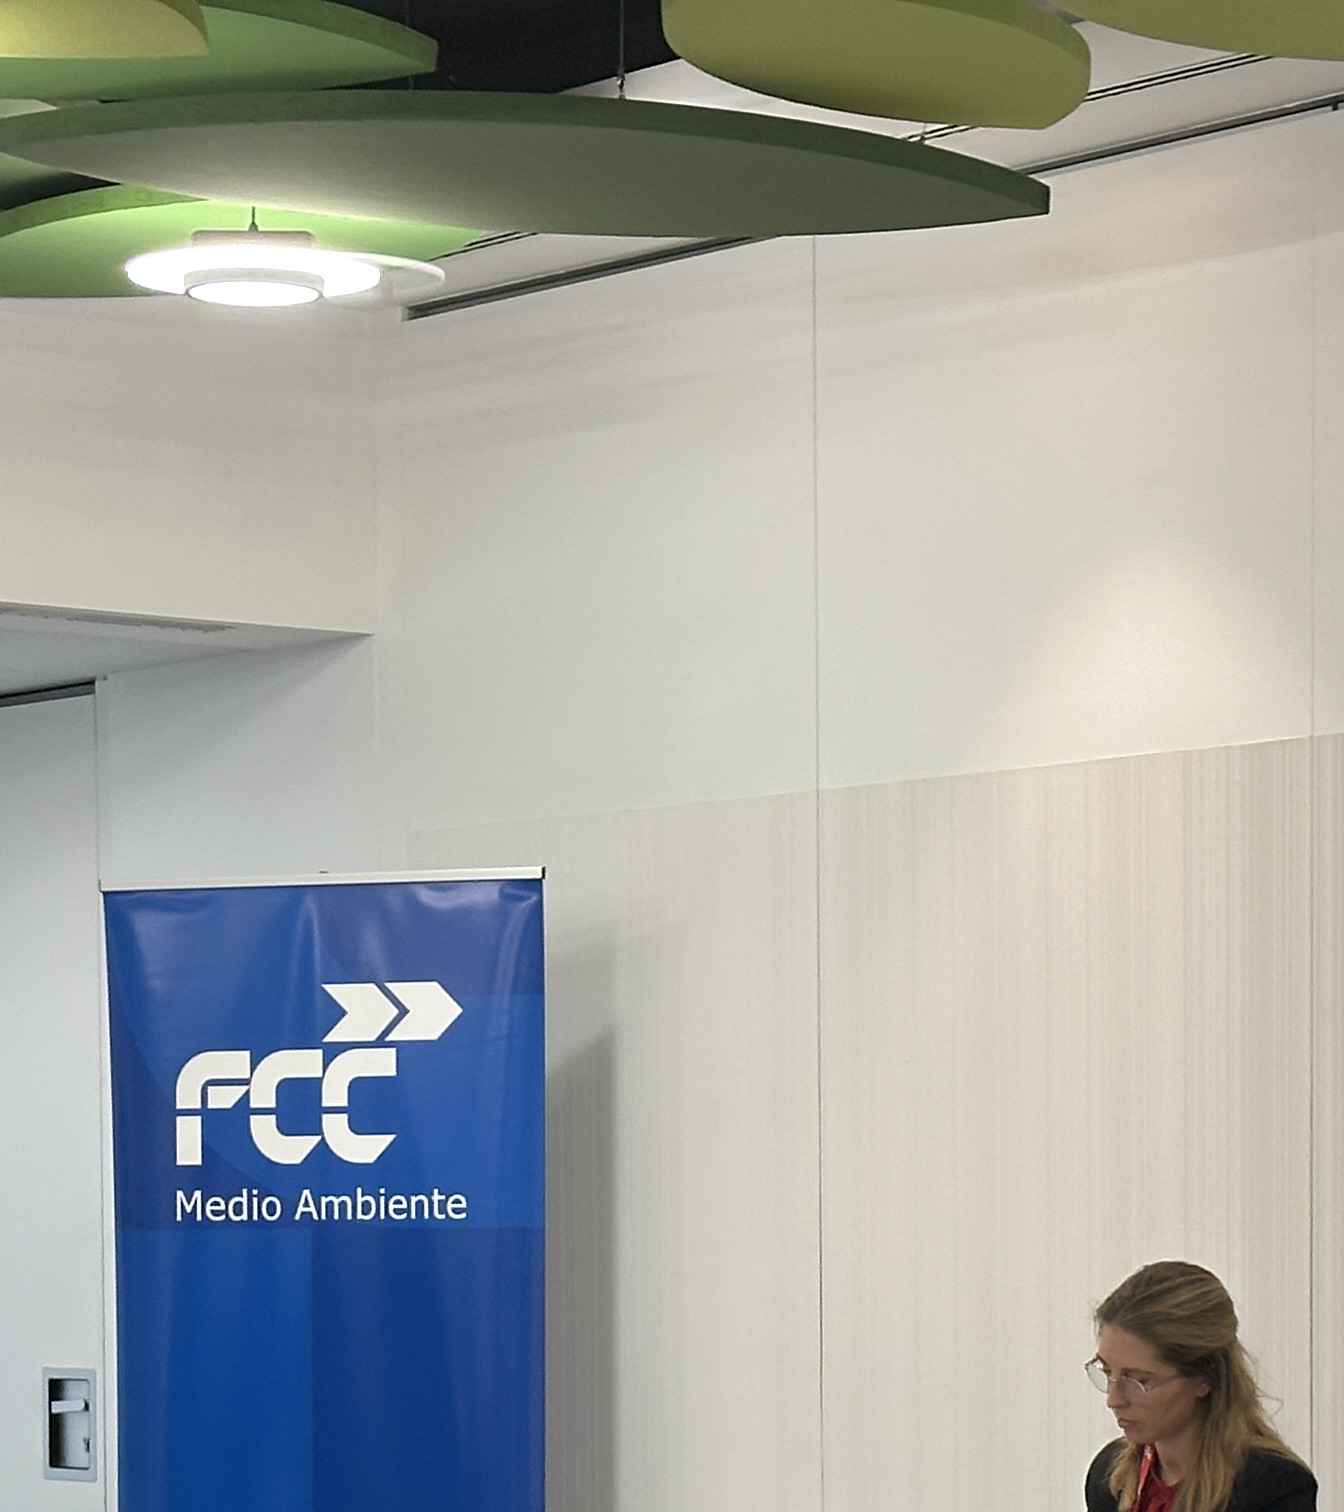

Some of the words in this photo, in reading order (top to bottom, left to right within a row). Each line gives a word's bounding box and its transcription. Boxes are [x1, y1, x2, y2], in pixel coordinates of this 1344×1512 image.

[175, 1047, 397, 1166] FCC
[175, 1188, 282, 1222] Medio
[294, 1187, 468, 1221] Ambiente
